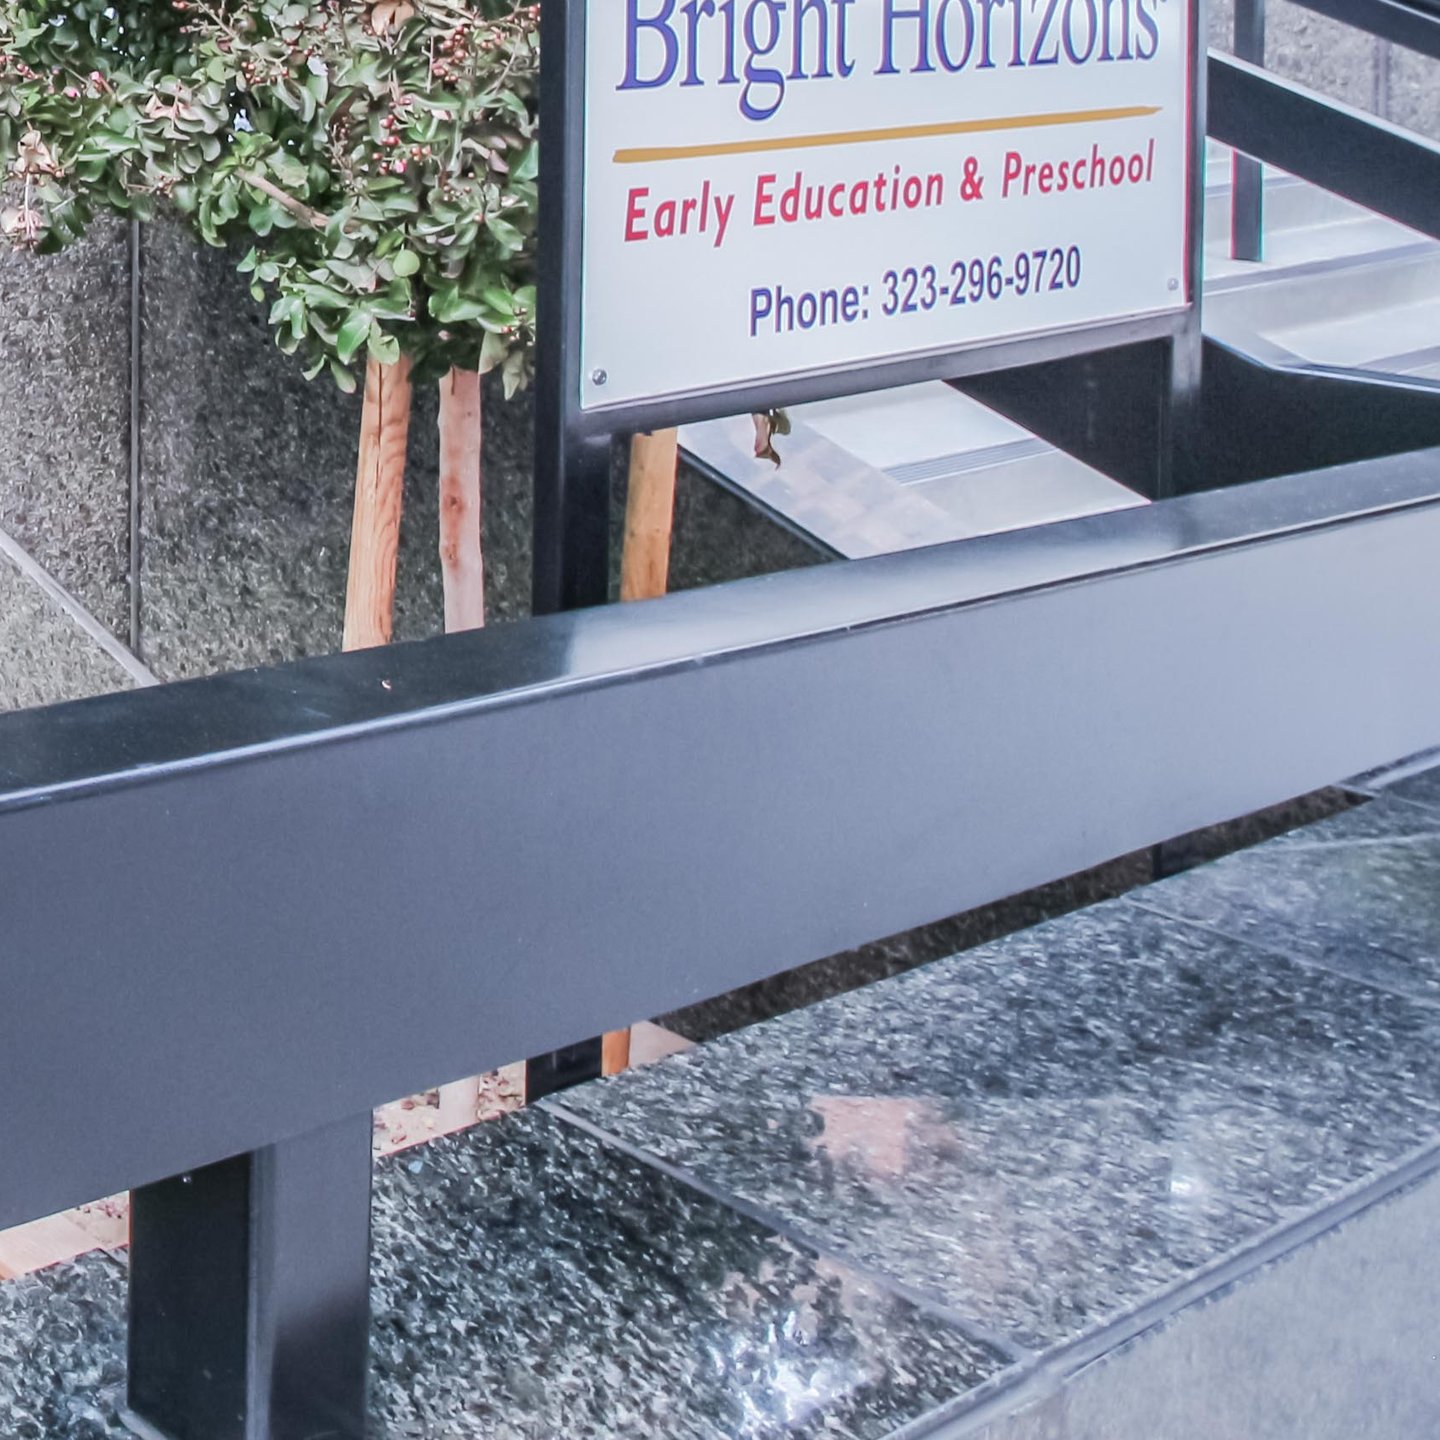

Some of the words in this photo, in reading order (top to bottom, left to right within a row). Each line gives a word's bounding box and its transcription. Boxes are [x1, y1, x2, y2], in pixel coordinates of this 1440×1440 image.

[624, 180, 735, 248] Early
[753, 164, 944, 227] Education
[960, 156, 984, 202] &
[1002, 138, 1155, 198] Preschool
[750, 285, 869, 337] Phone:
[881, 244, 1081, 316] 323-296-9720
